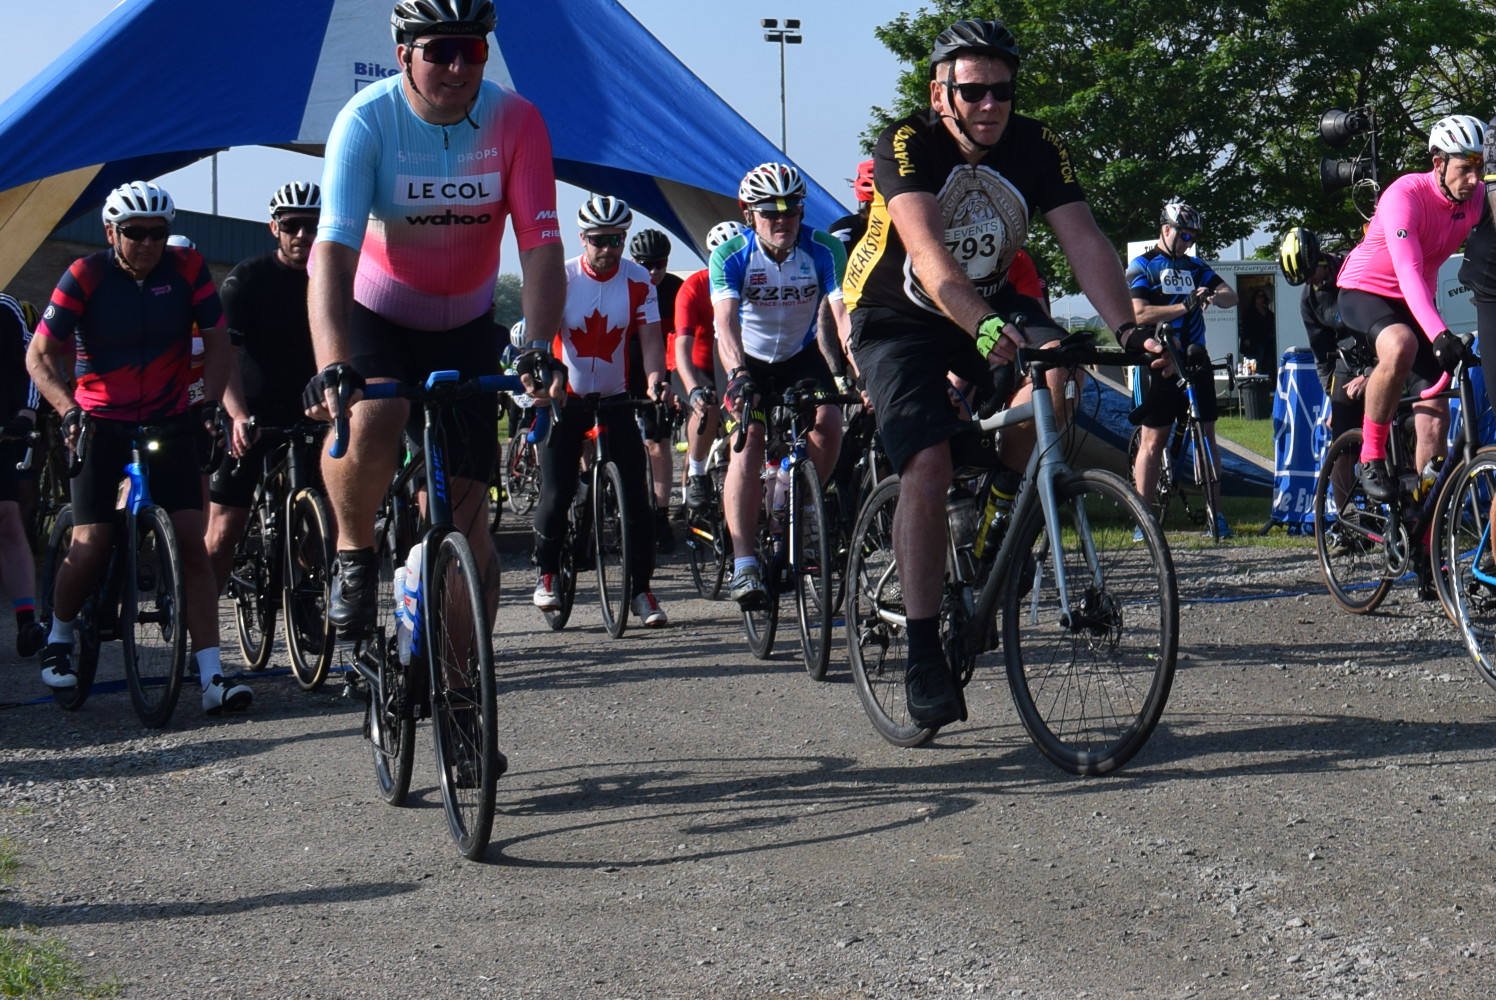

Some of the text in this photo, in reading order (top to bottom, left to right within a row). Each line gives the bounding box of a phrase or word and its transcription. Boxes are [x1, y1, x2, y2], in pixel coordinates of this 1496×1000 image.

[458, 148, 498, 162] DROPS
[408, 182, 490, 199] LE COL
[405, 209, 491, 225] wahoo
[954, 221, 998, 239] EVENTS
[846, 215, 884, 288] THEAKSTON
[1163, 276, 1192, 287] 6610
